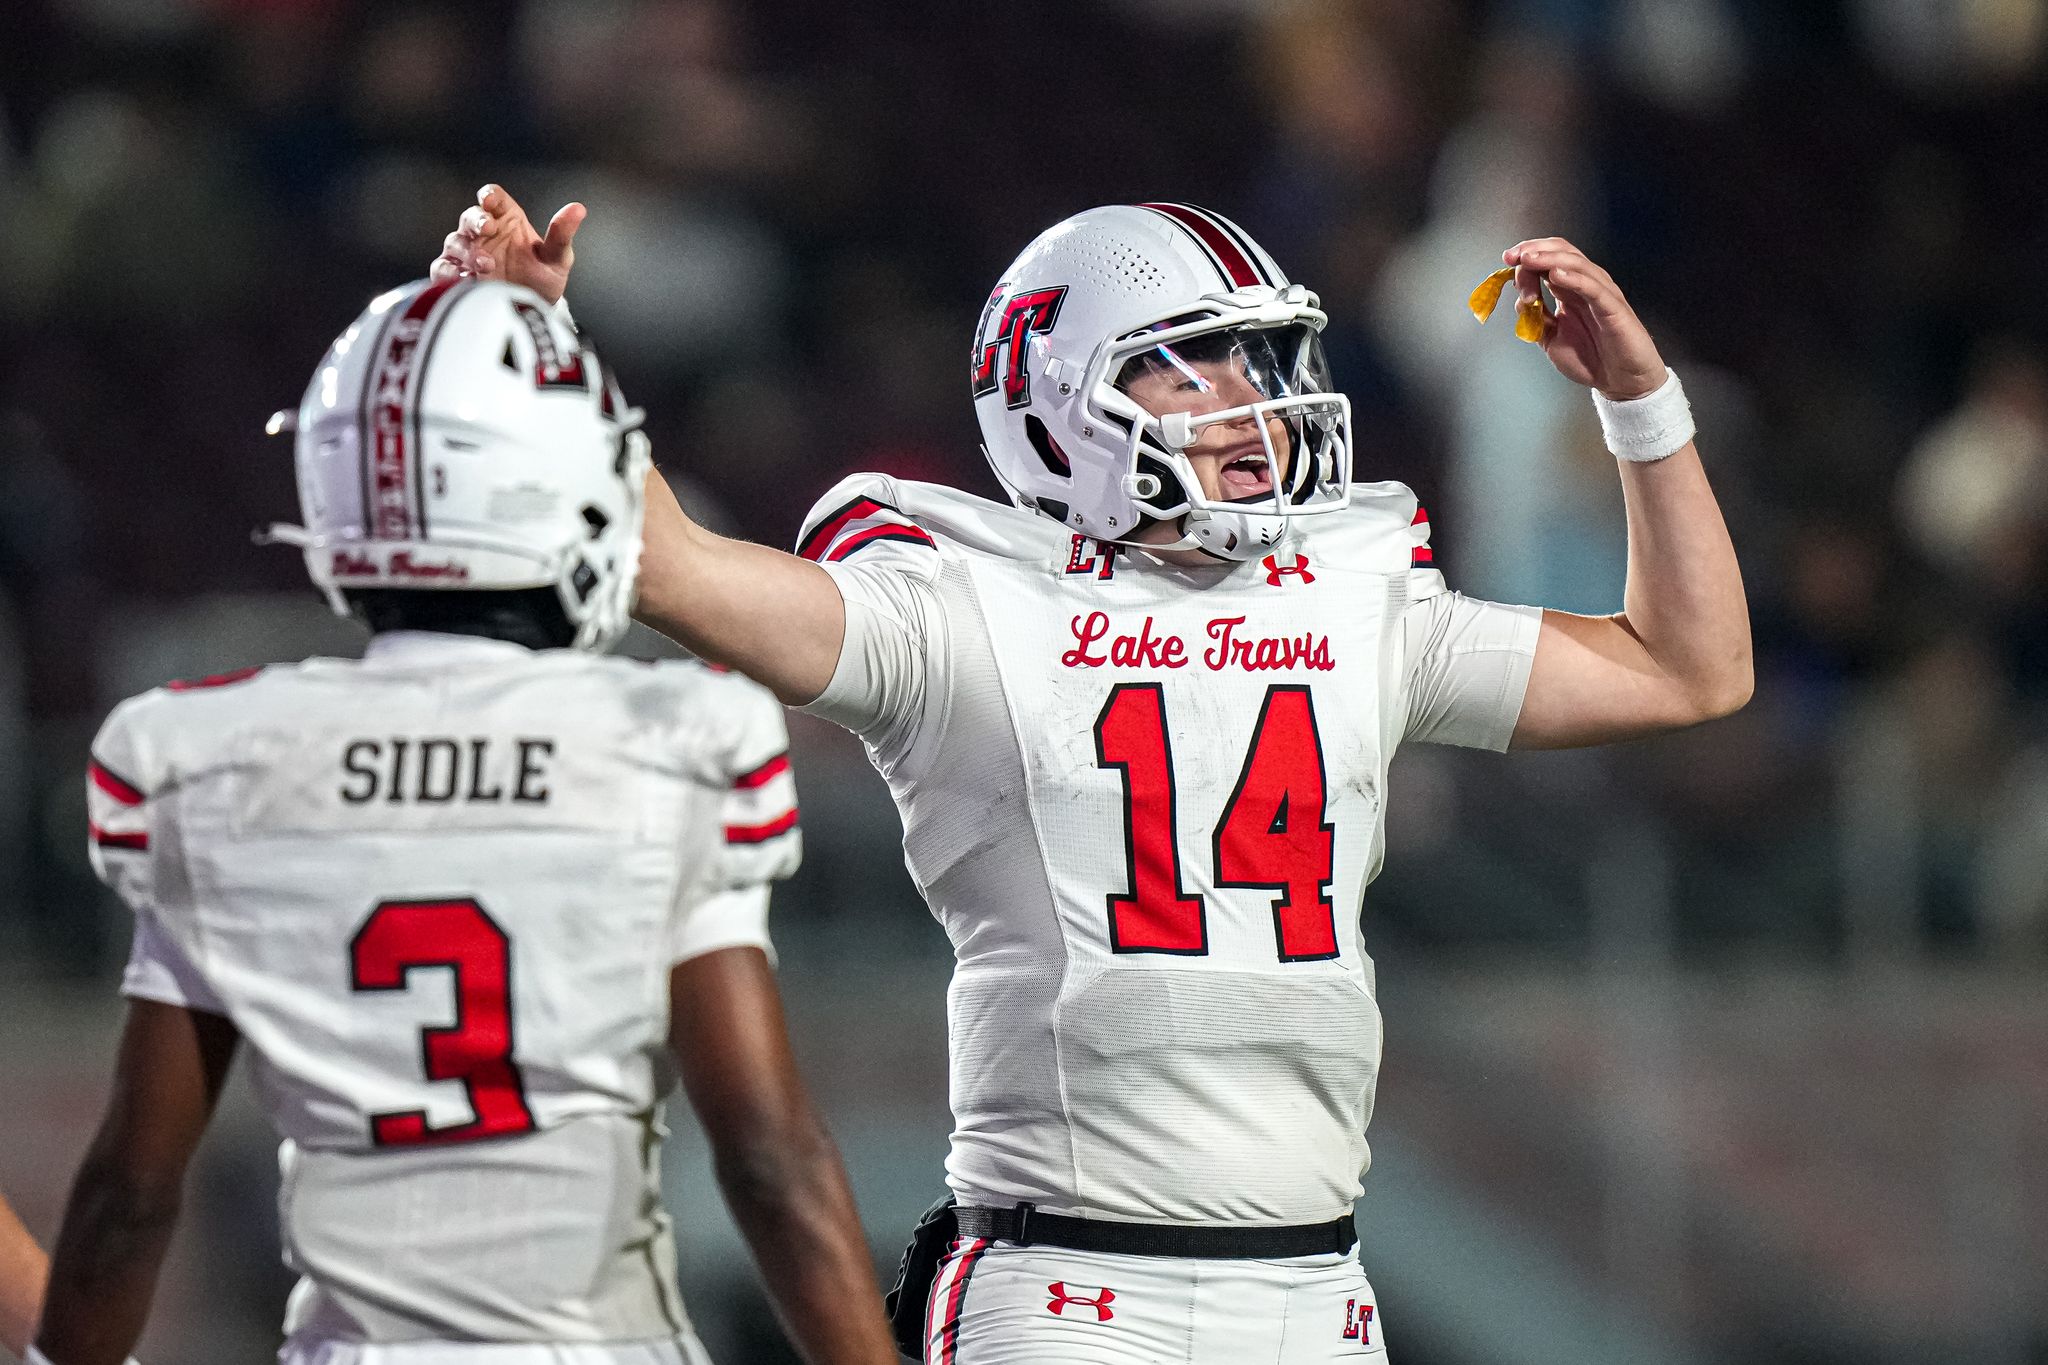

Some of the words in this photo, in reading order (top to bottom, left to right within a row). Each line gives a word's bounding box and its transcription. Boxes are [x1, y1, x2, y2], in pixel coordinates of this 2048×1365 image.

[971, 283, 1069, 411] LT
[1066, 533, 1126, 580] LT
[1061, 611, 1189, 669] Lake
[1203, 615, 1336, 672] Travis
[340, 738, 556, 804] SIDLE
[1093, 681, 1341, 963] 14
[350, 897, 539, 1149] 3
[1343, 1298, 1374, 1345] LT
